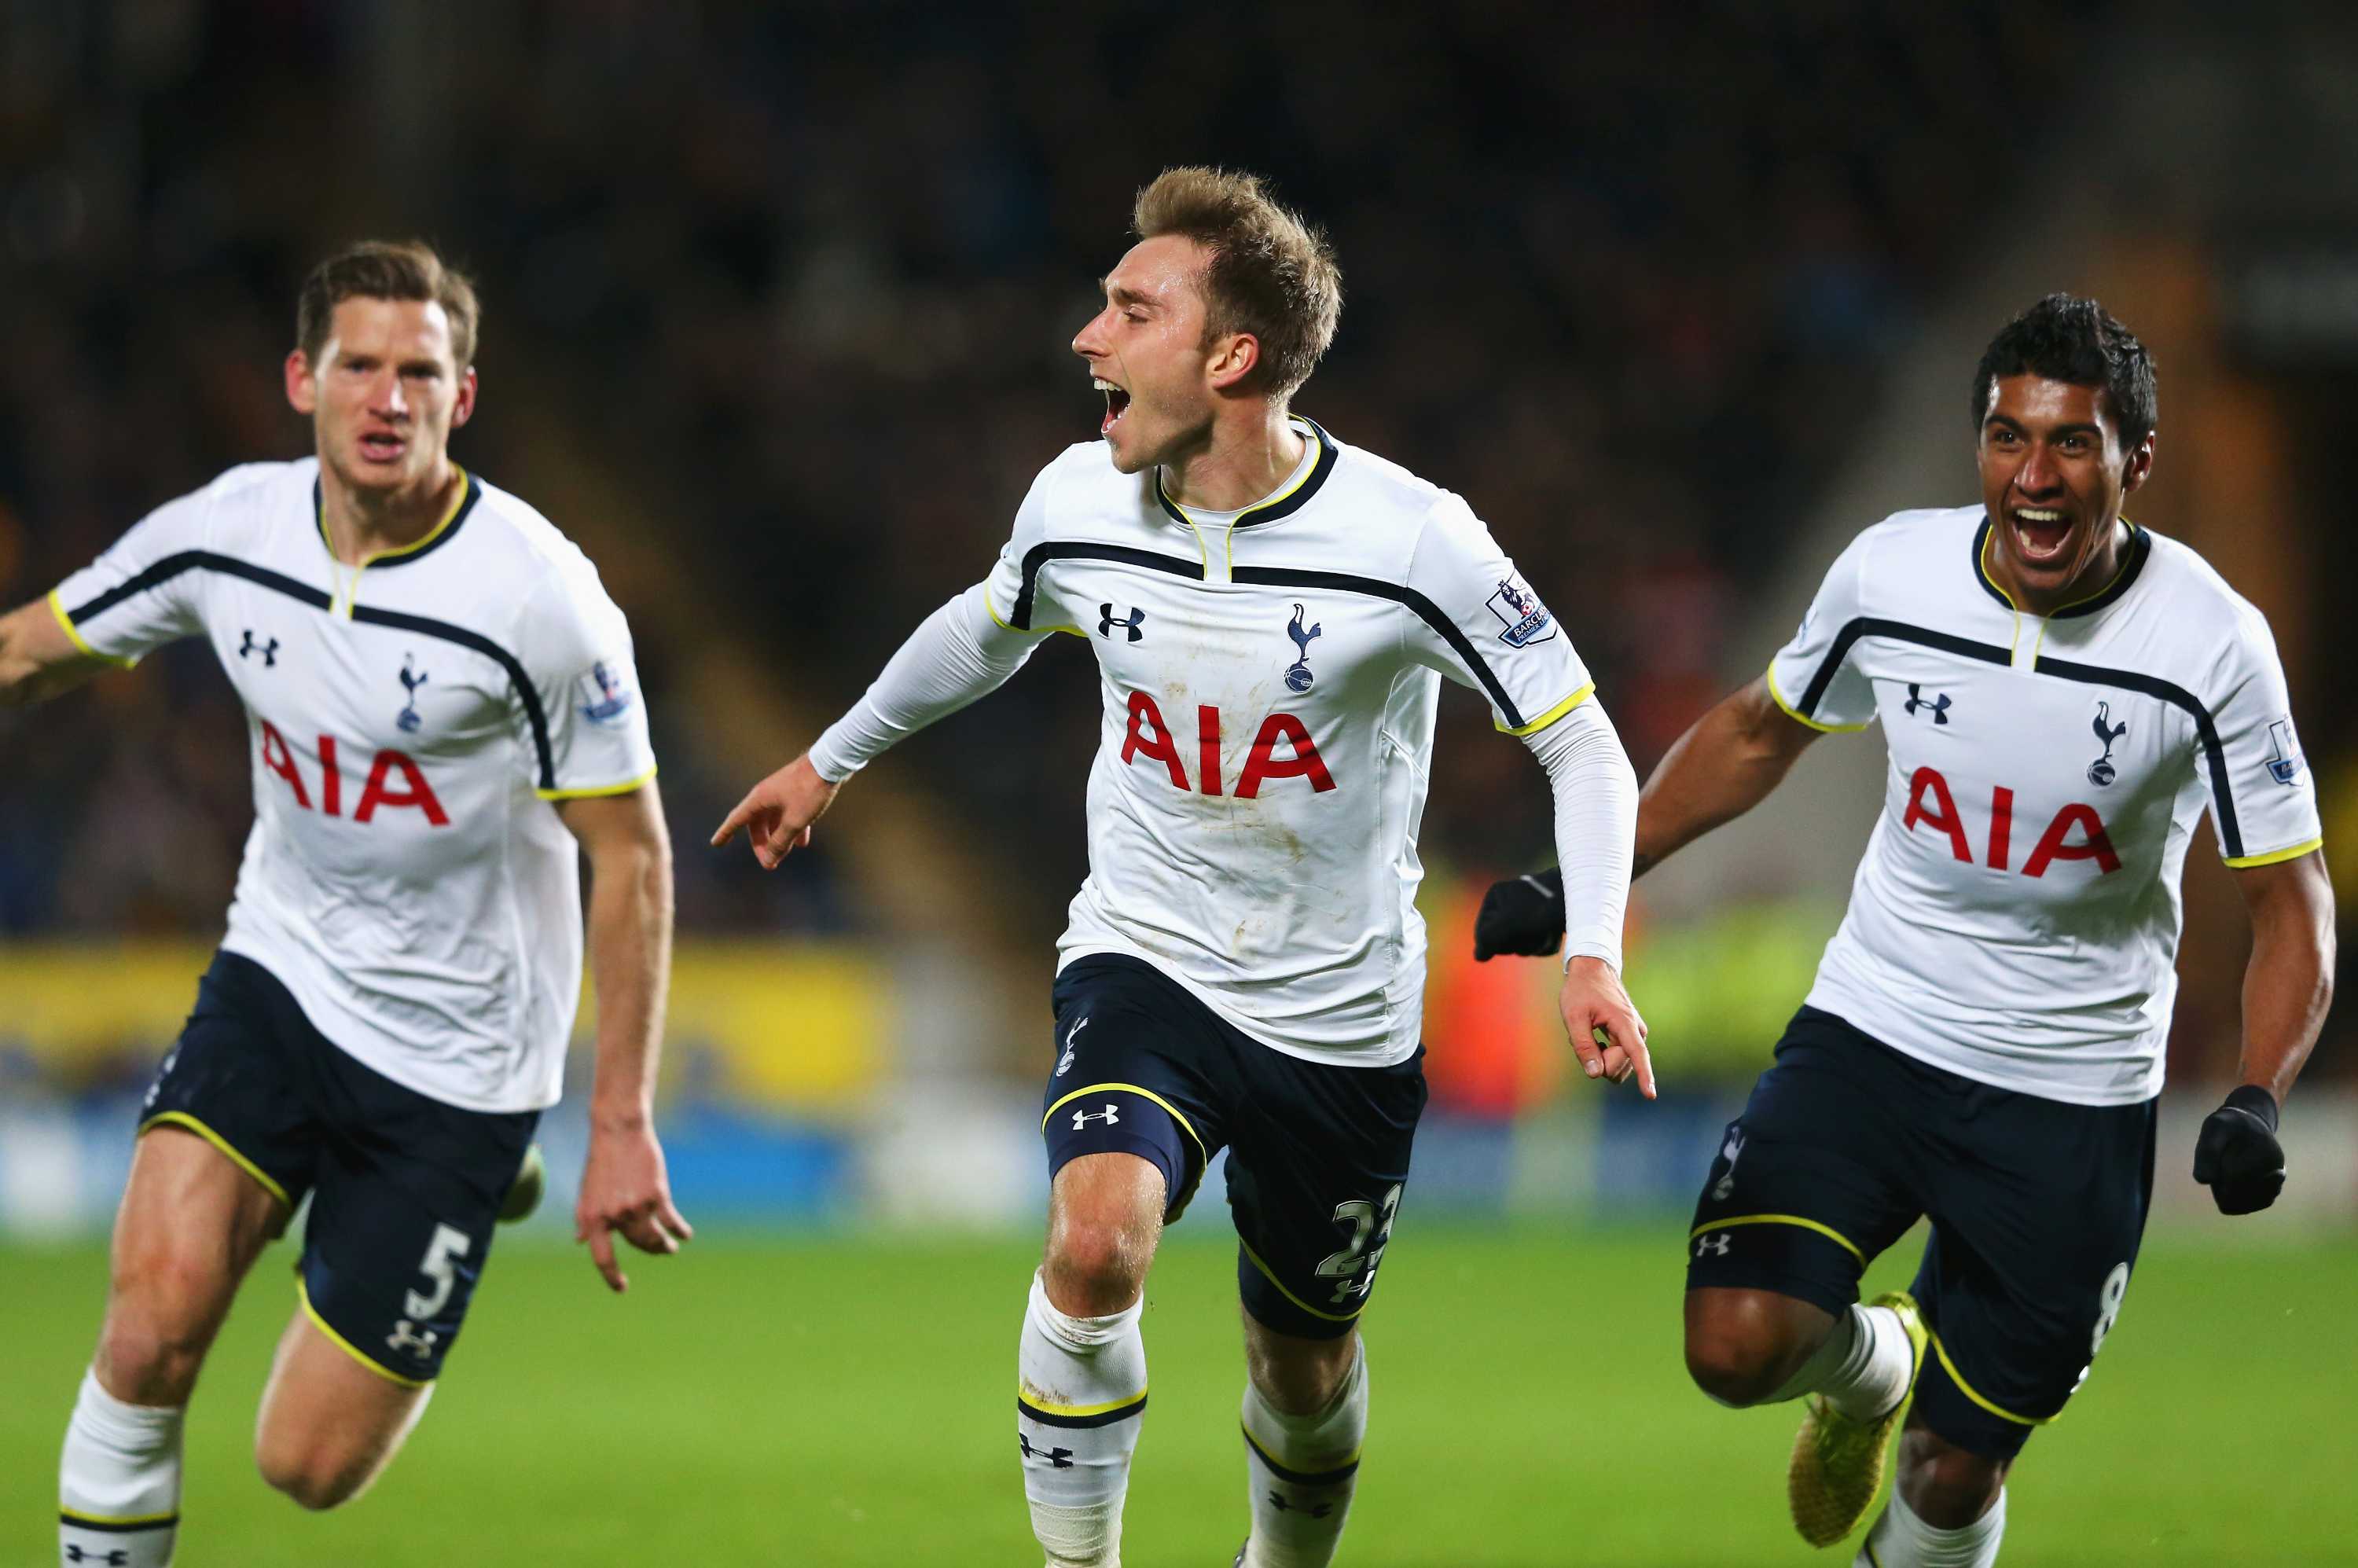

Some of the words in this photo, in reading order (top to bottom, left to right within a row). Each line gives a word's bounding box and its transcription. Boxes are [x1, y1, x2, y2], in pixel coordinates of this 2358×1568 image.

[260, 718, 450, 827] AIA
[1121, 691, 1337, 799] AIA
[1903, 766, 2121, 878] AIA
[404, 1221, 471, 1320] 5
[2092, 1261, 2128, 1357] 8
